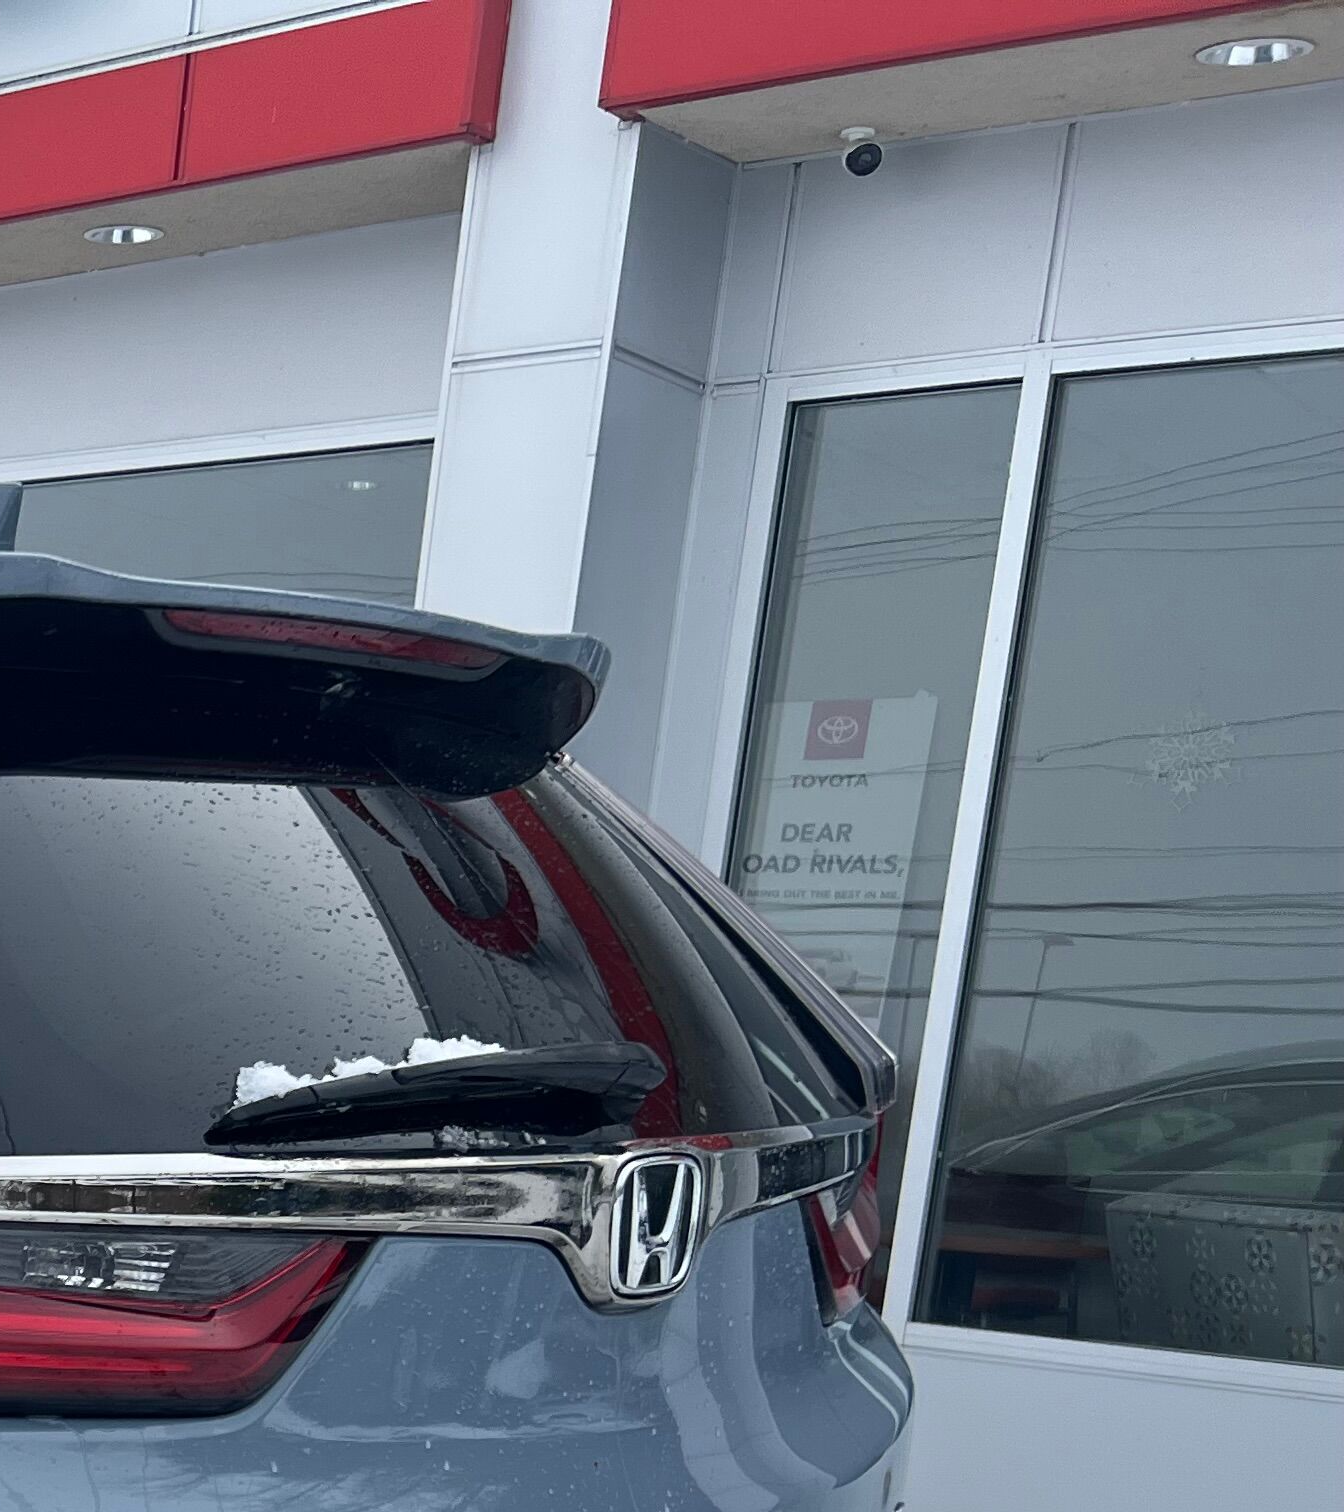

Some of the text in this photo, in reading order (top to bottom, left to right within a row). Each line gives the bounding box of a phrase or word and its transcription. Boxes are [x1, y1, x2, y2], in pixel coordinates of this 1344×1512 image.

[790, 773, 869, 789] TOYOTA
[779, 822, 853, 843] DEAR
[742, 853, 905, 877] OAD RIVALS,
